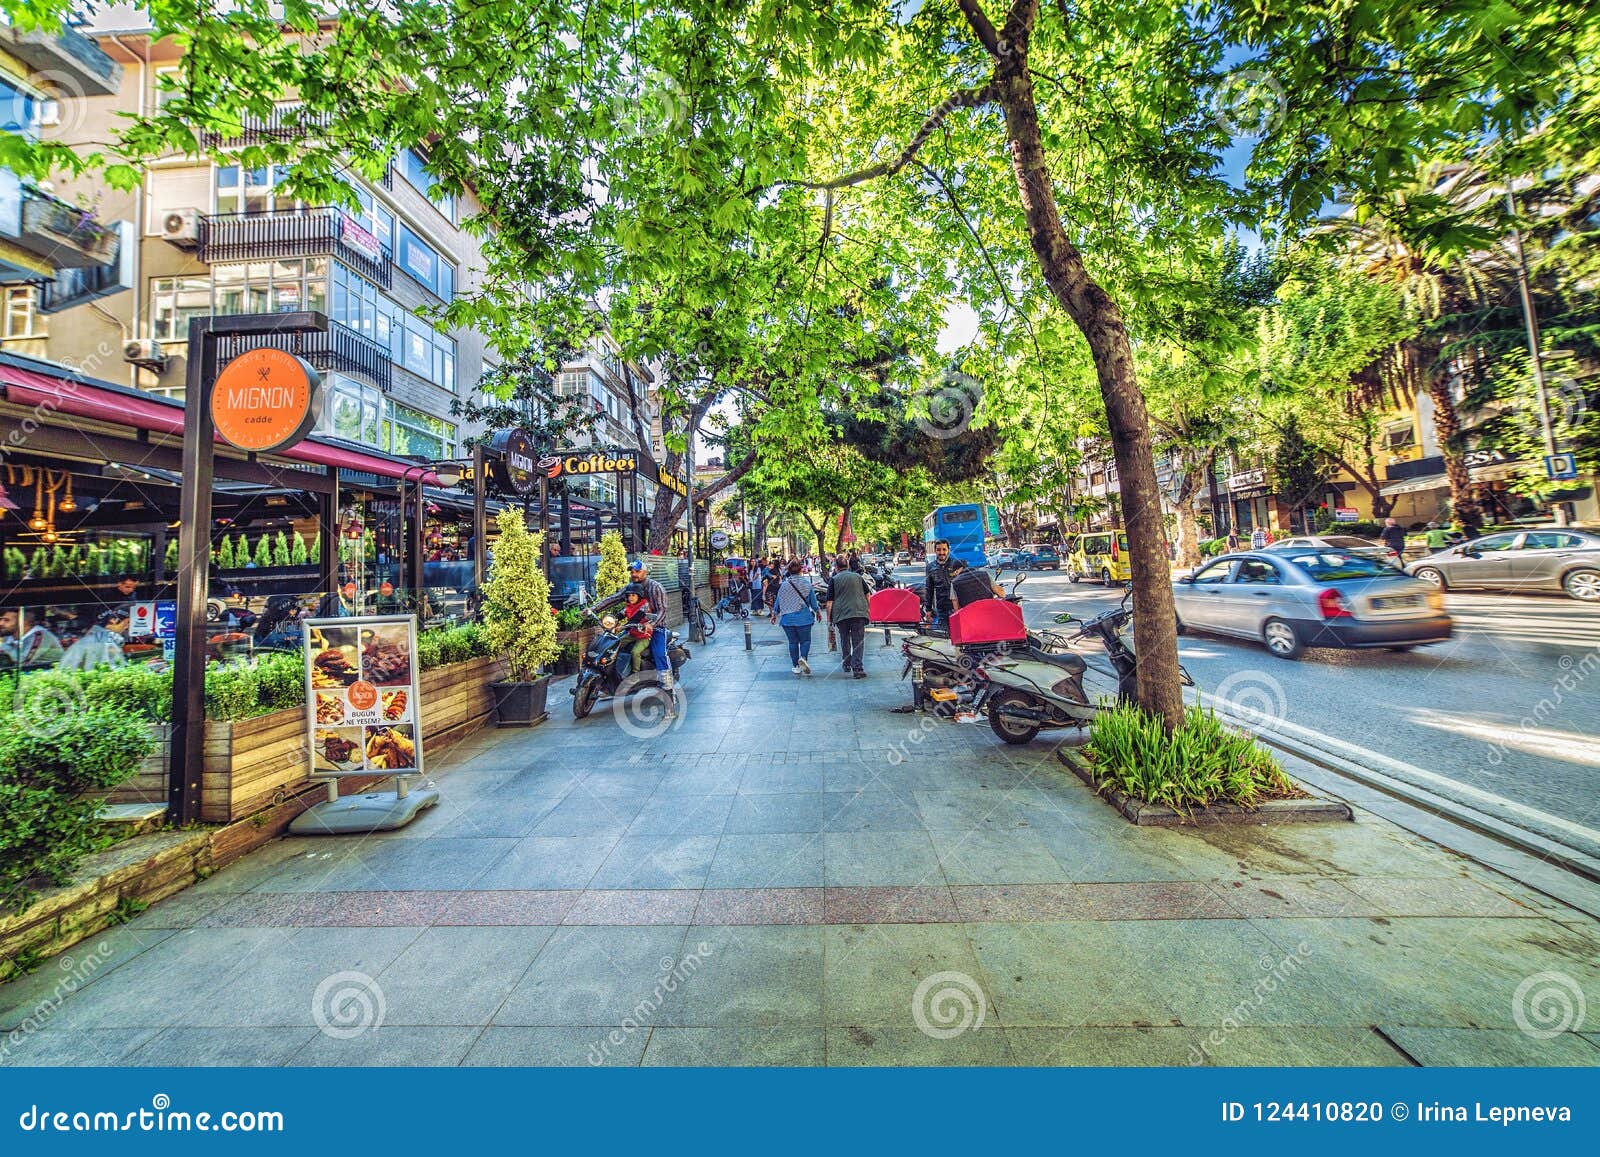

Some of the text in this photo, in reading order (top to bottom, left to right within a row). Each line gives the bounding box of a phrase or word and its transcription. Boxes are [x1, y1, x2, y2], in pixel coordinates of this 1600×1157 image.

[244, 415, 273, 424] cadde
[564, 455, 635, 474] Coffees
[1552, 458, 1567, 473] D
